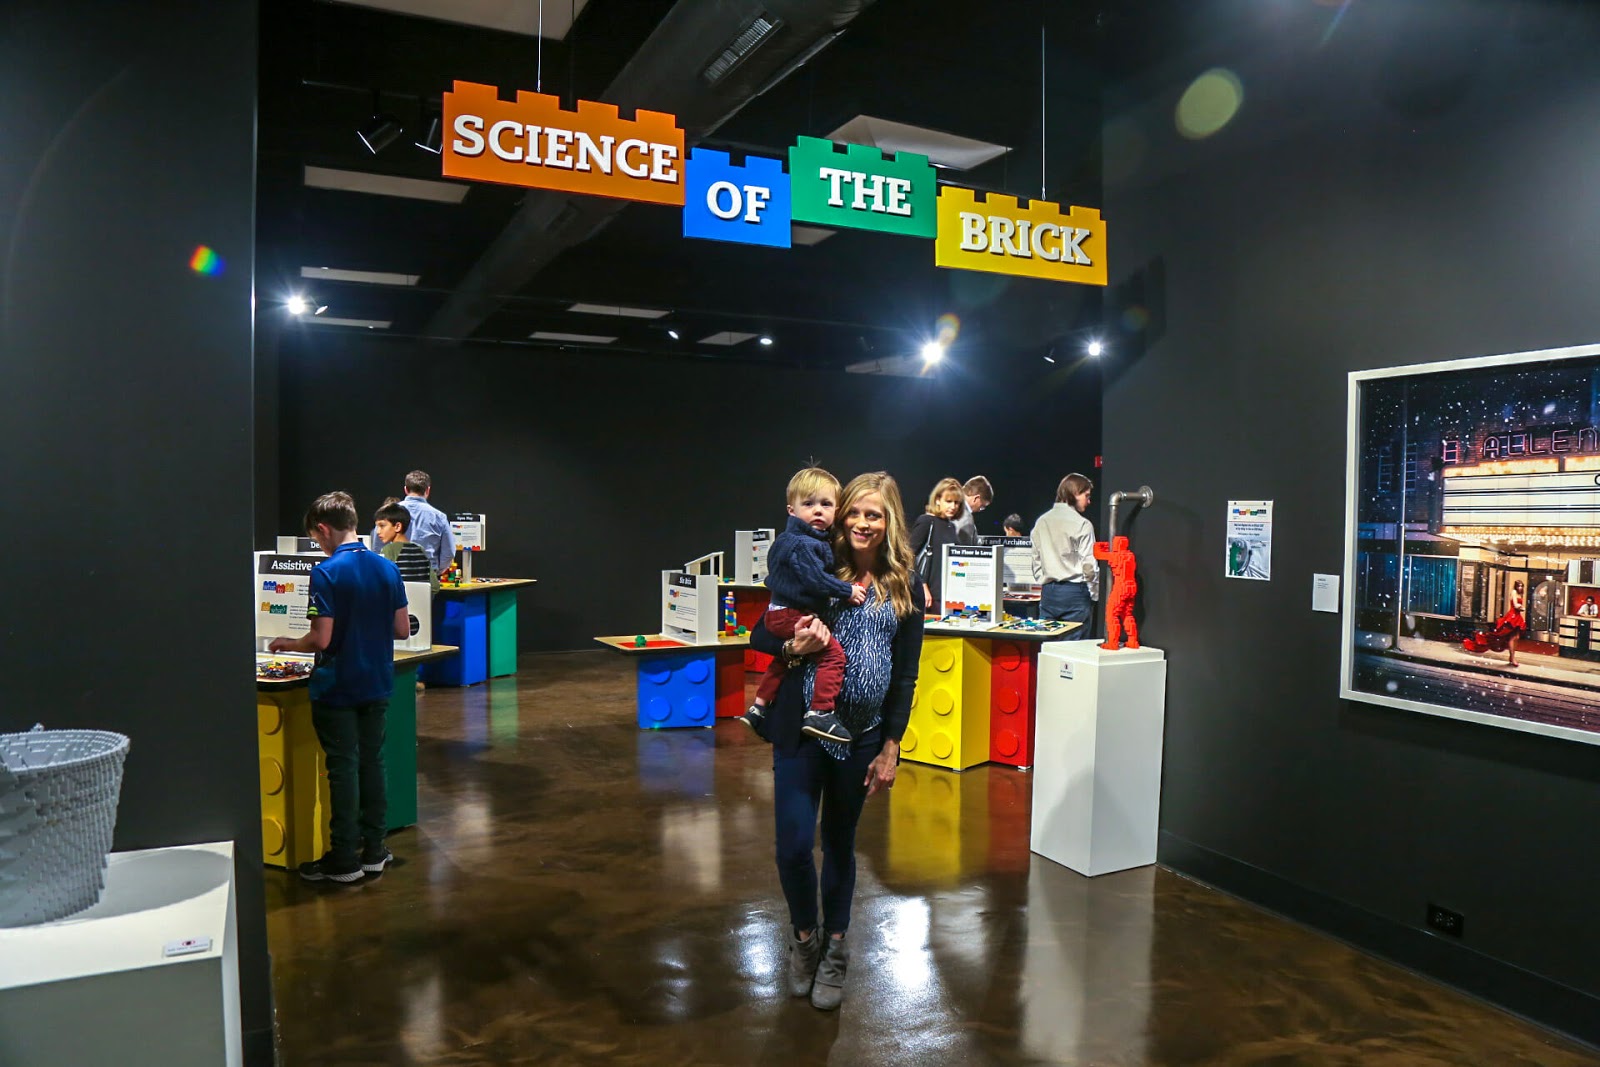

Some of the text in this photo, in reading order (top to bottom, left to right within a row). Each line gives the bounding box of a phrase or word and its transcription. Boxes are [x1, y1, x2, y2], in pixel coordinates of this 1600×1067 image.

[452, 114, 1091, 265] SCIENCE OF THE BRICK
[310, 541, 321, 549] De
[1003, 538, 1032, 546] Architect
[271, 559, 312, 571] Assistive
